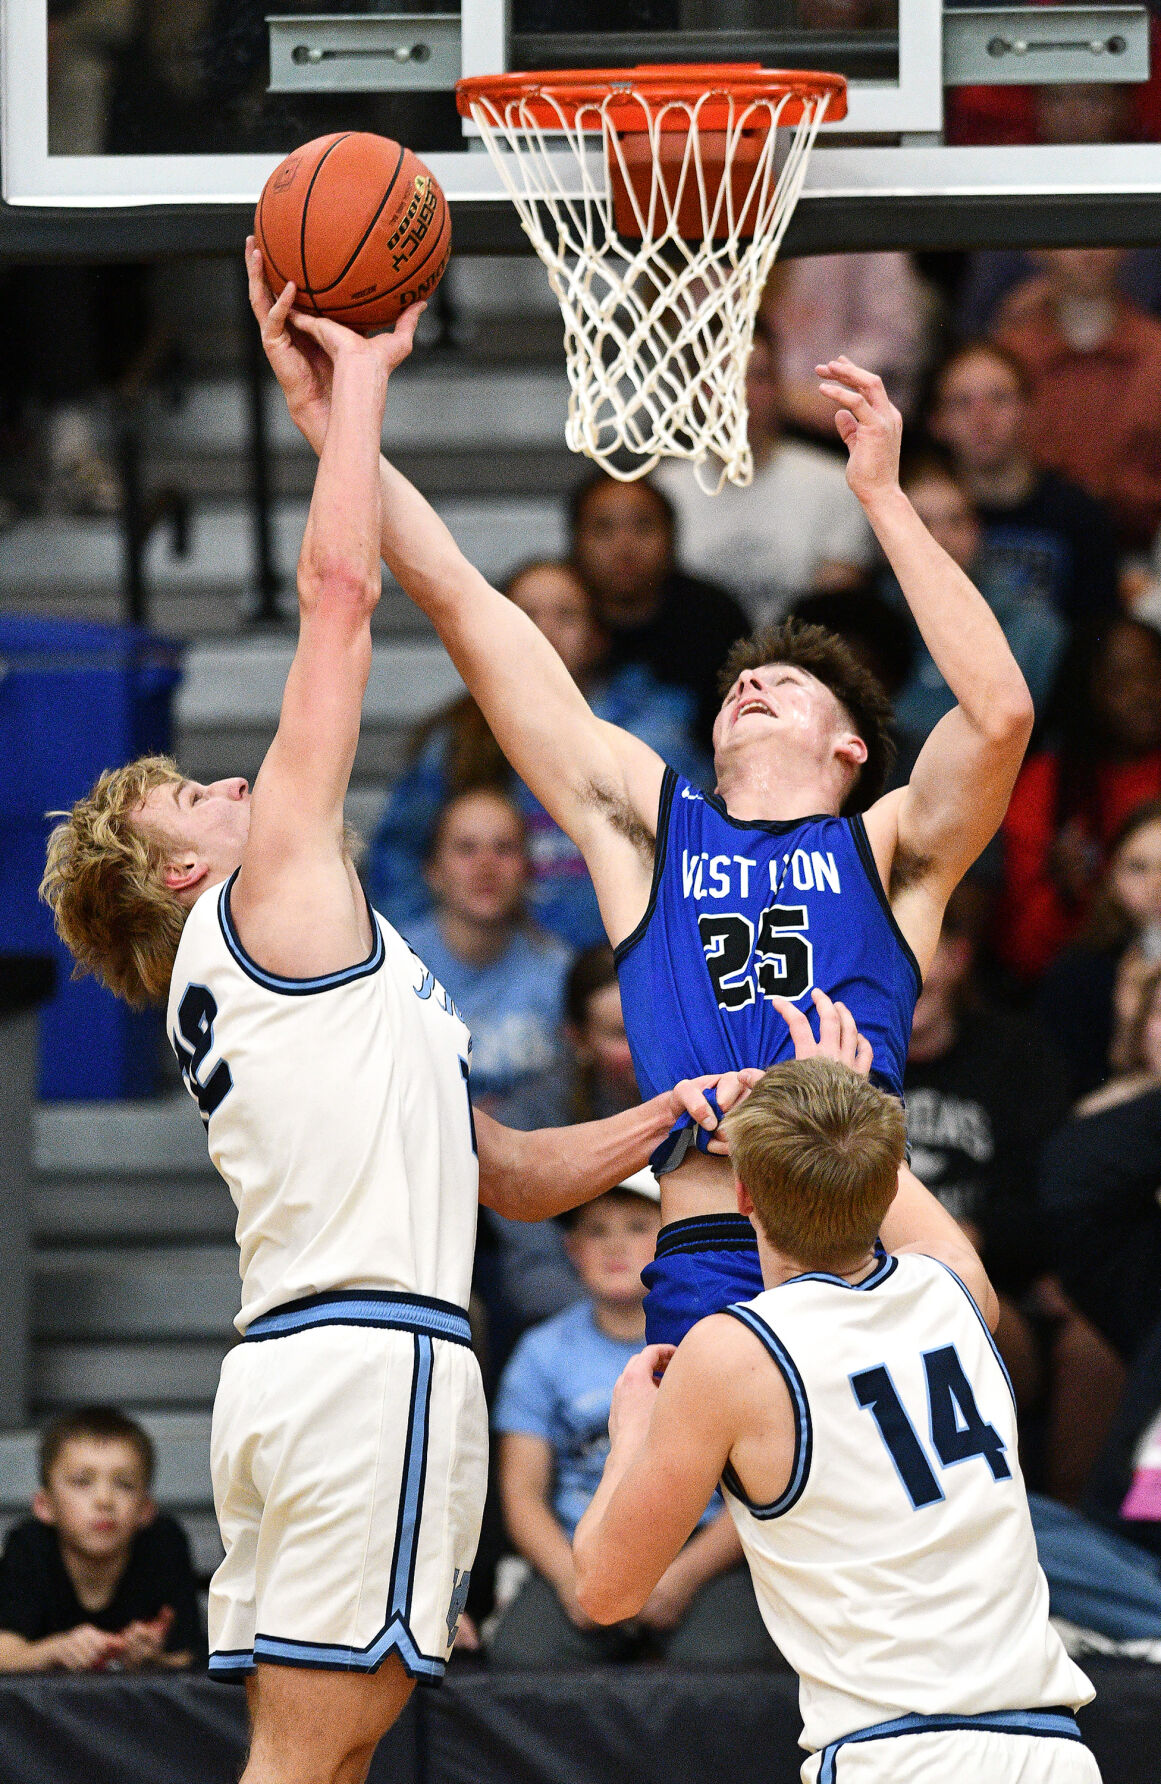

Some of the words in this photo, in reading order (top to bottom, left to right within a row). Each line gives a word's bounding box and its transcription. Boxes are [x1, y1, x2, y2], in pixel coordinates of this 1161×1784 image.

[386, 190, 422, 251] 1000
[391, 176, 438, 273] LEGACY
[698, 903, 813, 1012] 25
[848, 1341, 1013, 1512] 14
